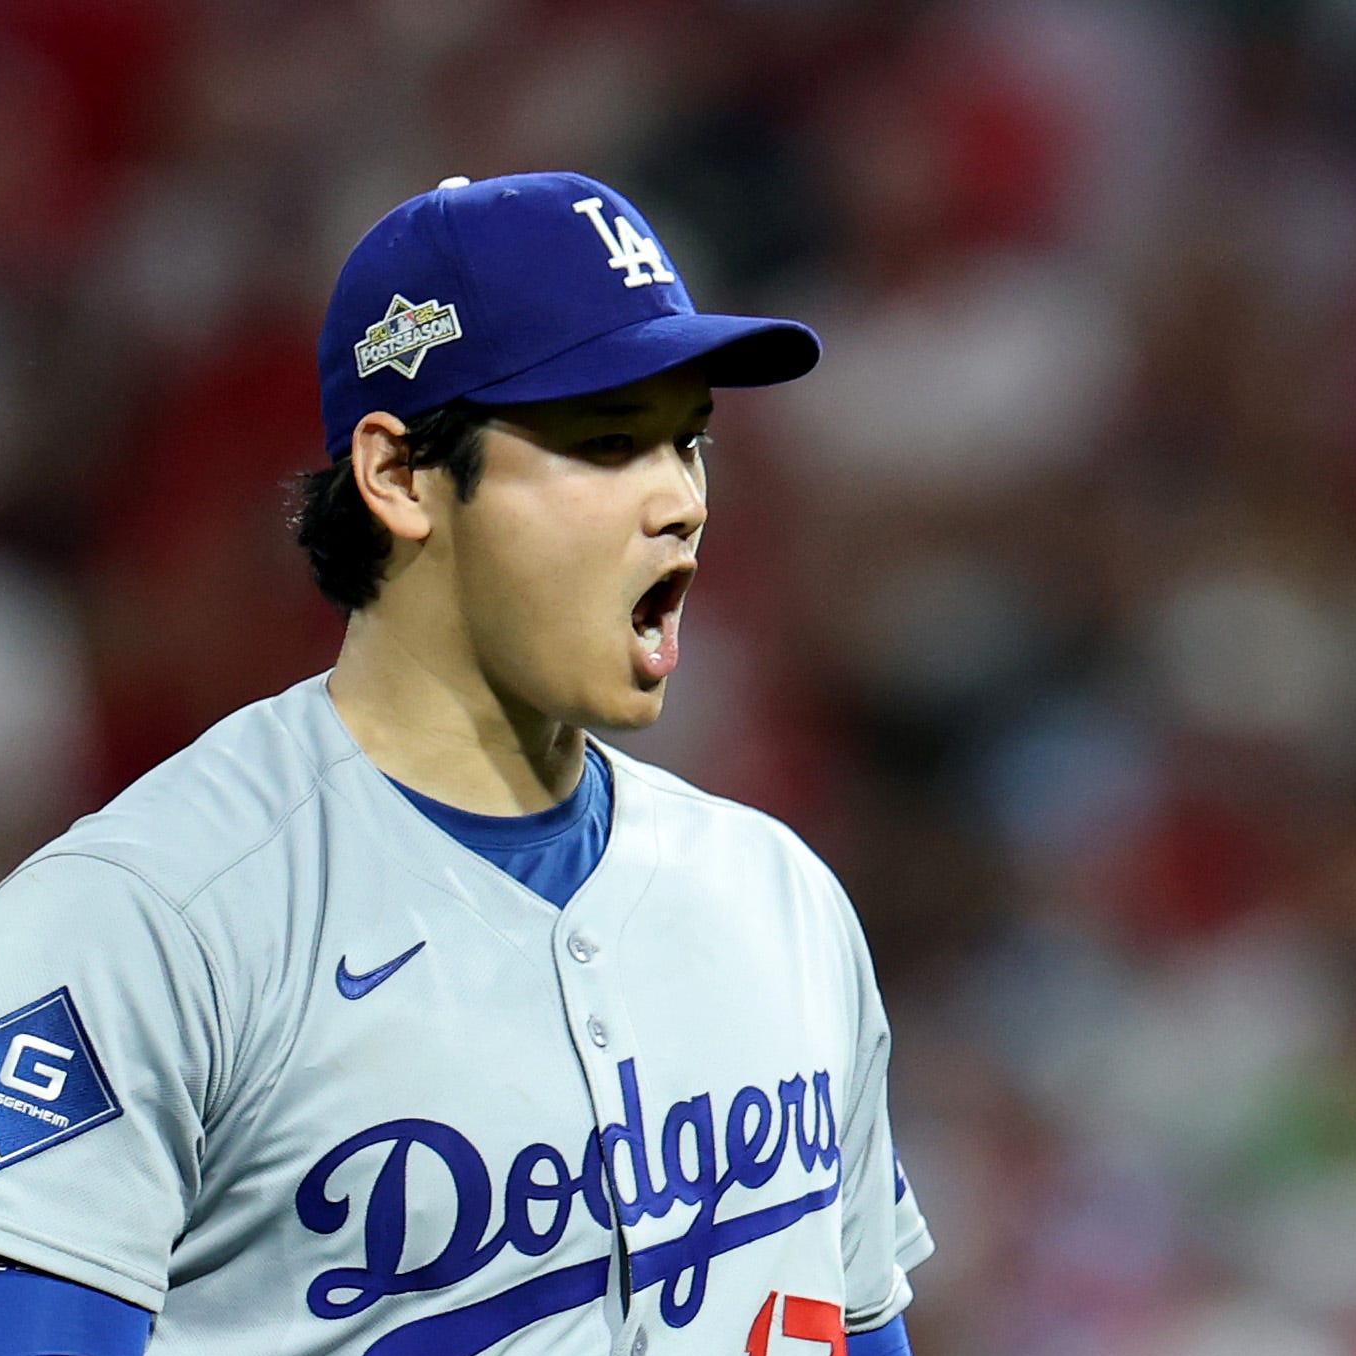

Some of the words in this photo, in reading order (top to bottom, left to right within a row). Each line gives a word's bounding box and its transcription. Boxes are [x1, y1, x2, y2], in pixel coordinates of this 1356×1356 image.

[572, 197, 675, 288] LA
[359, 315, 453, 369] POSTSEASON
[0, 1033, 75, 1101] G
[296, 1057, 842, 1330] Dodgers
